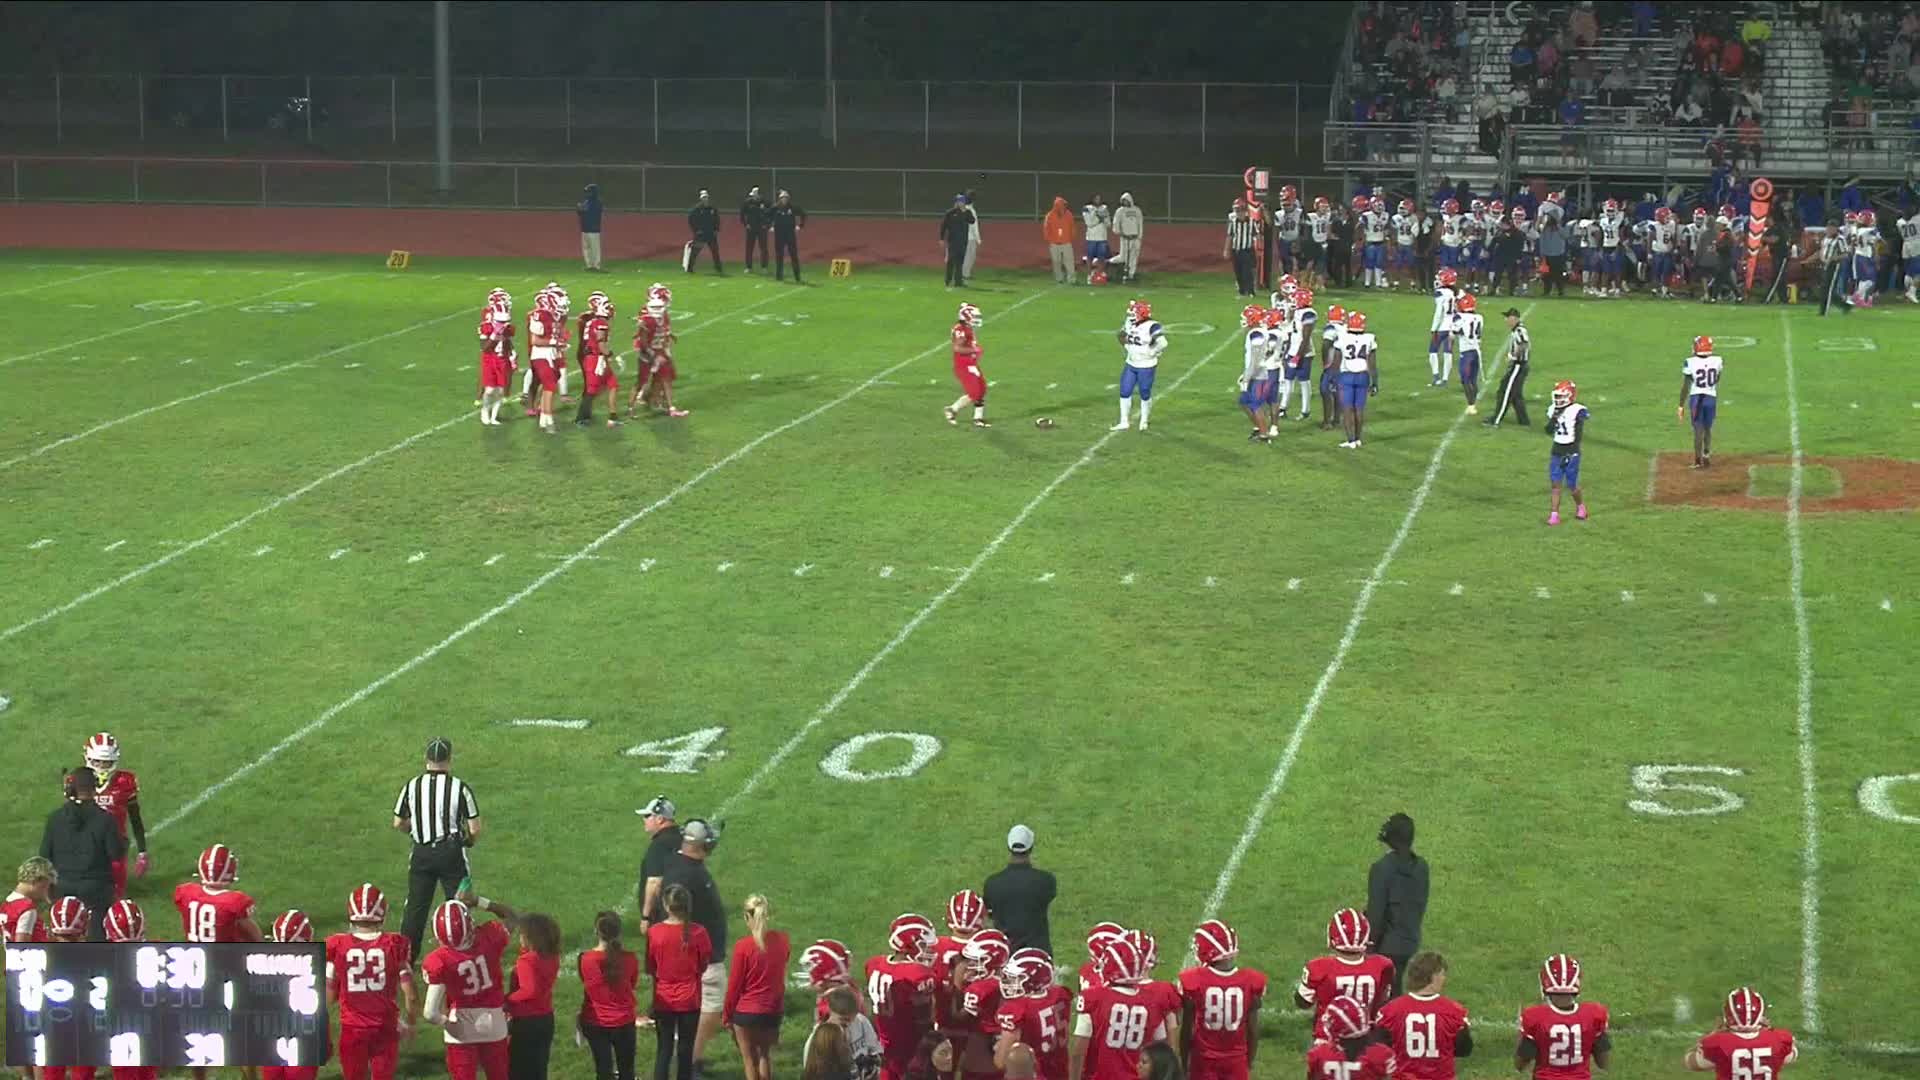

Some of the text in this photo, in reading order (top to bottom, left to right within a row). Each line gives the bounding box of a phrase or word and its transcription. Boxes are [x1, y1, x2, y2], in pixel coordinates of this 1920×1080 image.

[391, 253, 406, 266] 20
[832, 262, 845, 275] 30
[1469, 321, 1481, 339] 14
[1345, 344, 1367, 360] 34
[1695, 368, 1717, 388] 20
[186, 900, 217, 942] 18
[346, 948, 386, 992] 23
[457, 955, 494, 996] 31
[1106, 1003, 1148, 1049] 88
[1204, 986, 1244, 1031] 80
[1405, 1012, 1440, 1058] 61
[1548, 1023, 1584, 1066] 21
[1731, 1047, 1772, 1080] 65
